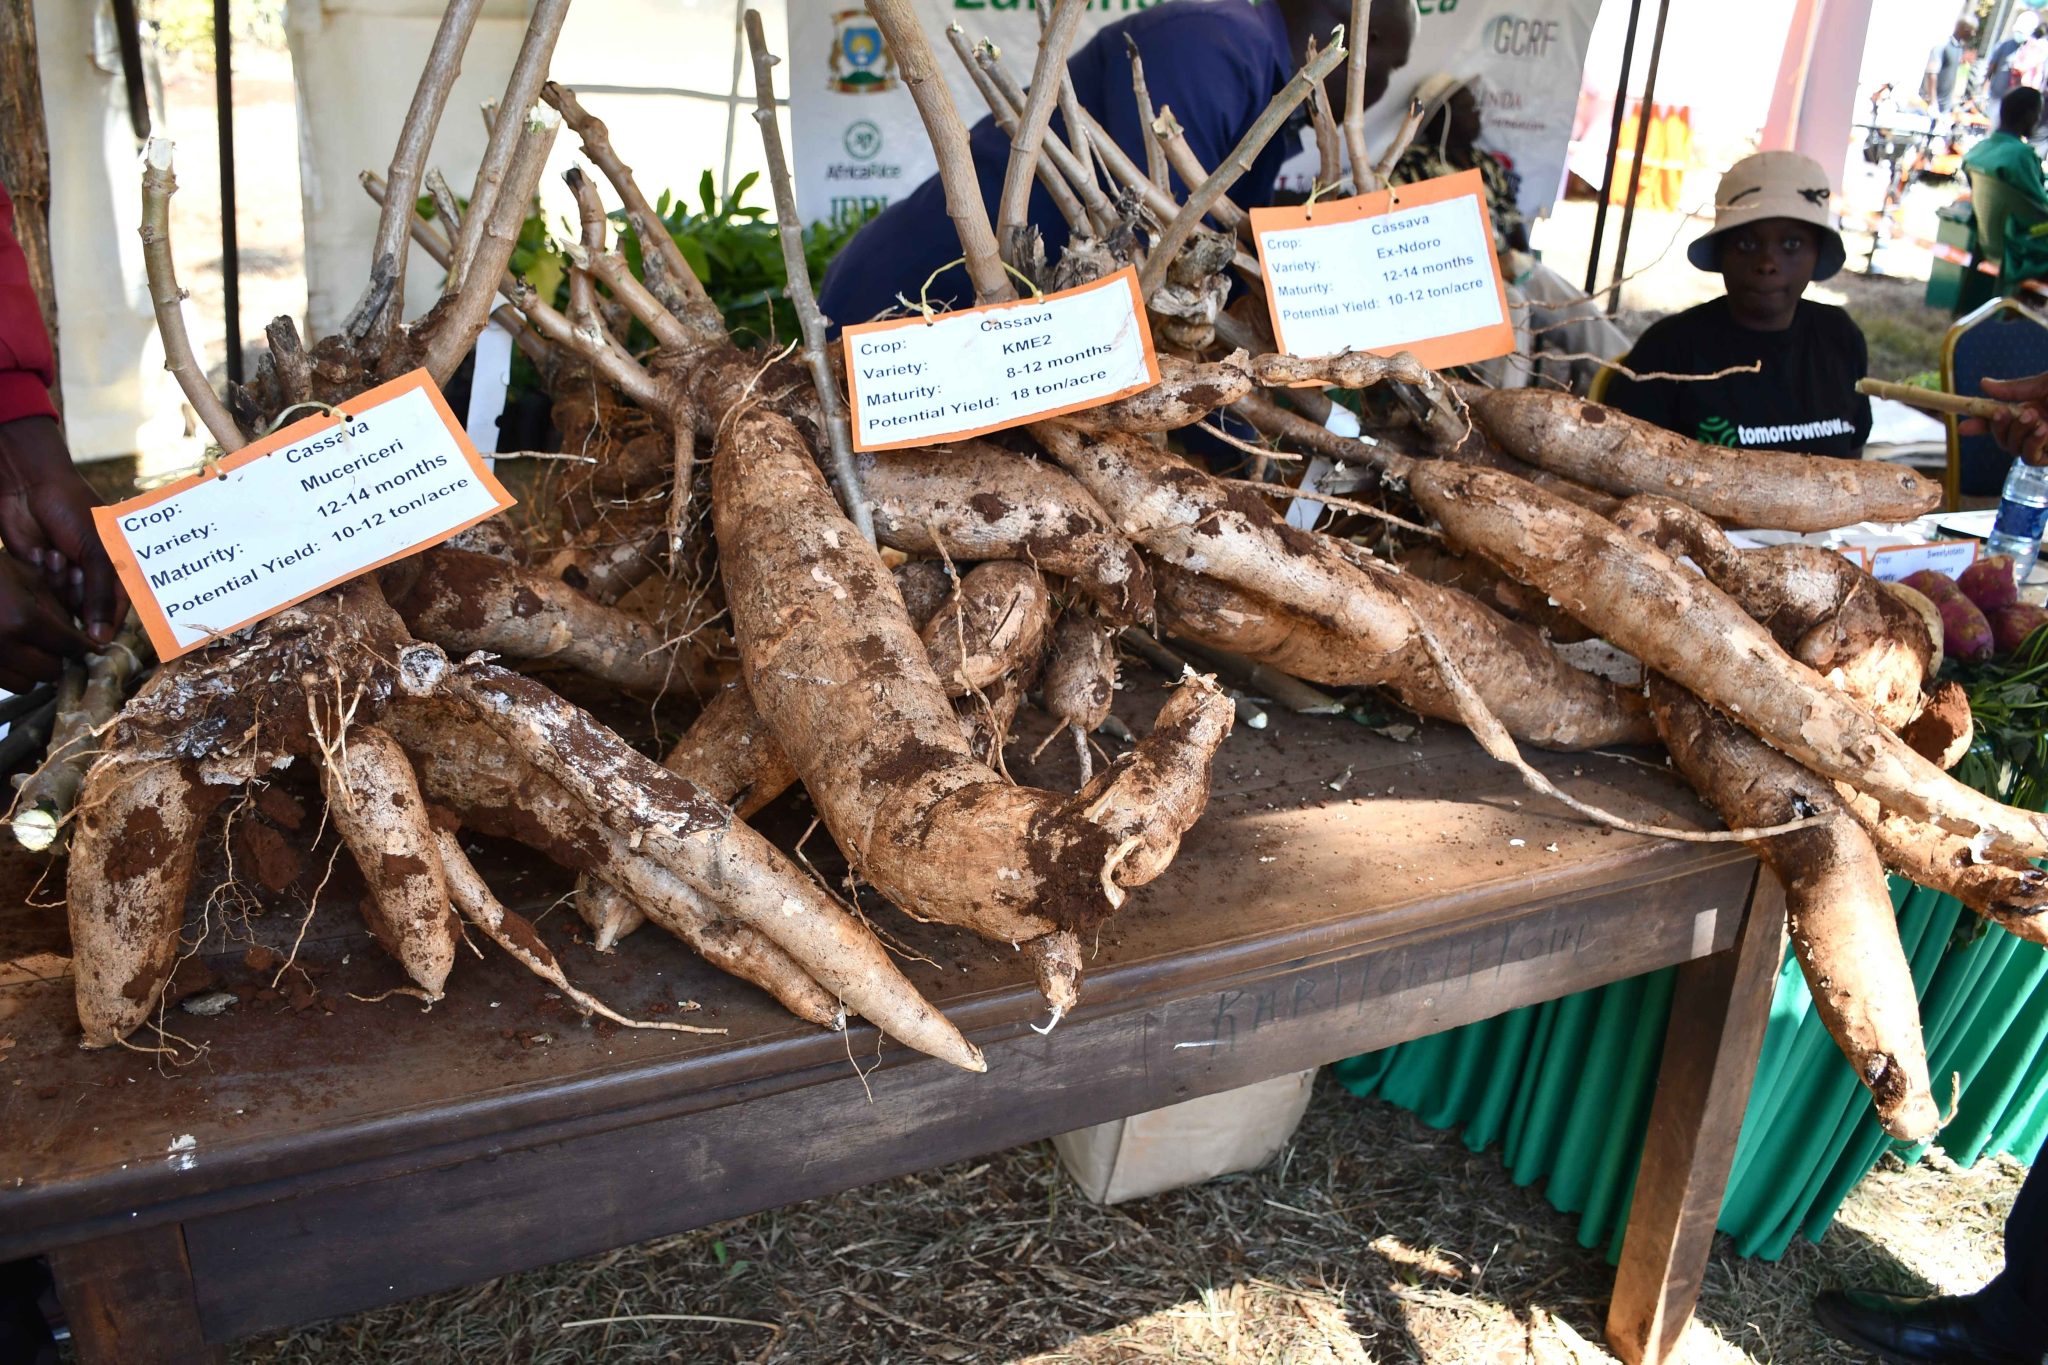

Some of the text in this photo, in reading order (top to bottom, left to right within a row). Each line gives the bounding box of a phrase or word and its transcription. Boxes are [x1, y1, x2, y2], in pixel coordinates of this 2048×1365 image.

[1494, 16, 1560, 57] GCRF
[1268, 216, 1429, 250] Crop: Cassava
[1272, 239, 1440, 274] Variety: Ex-Ndoro
[1278, 257, 1473, 296] Maturity: 12-14 months
[1283, 280, 1482, 320] Potential Yield: 10-12 ton/acre
[861, 313, 1052, 357] Crop: Cassava
[863, 335, 1051, 380] Variety: KME2
[867, 345, 1111, 407] Maturity: 8-12 months
[870, 371, 1106, 429] Potential Yield: 18 ton/acre
[124, 423, 369, 533] Crop: Cassava
[137, 436, 405, 563] Variety: Mucericeri
[151, 456, 449, 591] Maturity: 12-14 months
[166, 475, 468, 617] Potential Yield: 10-12 ton/acre
